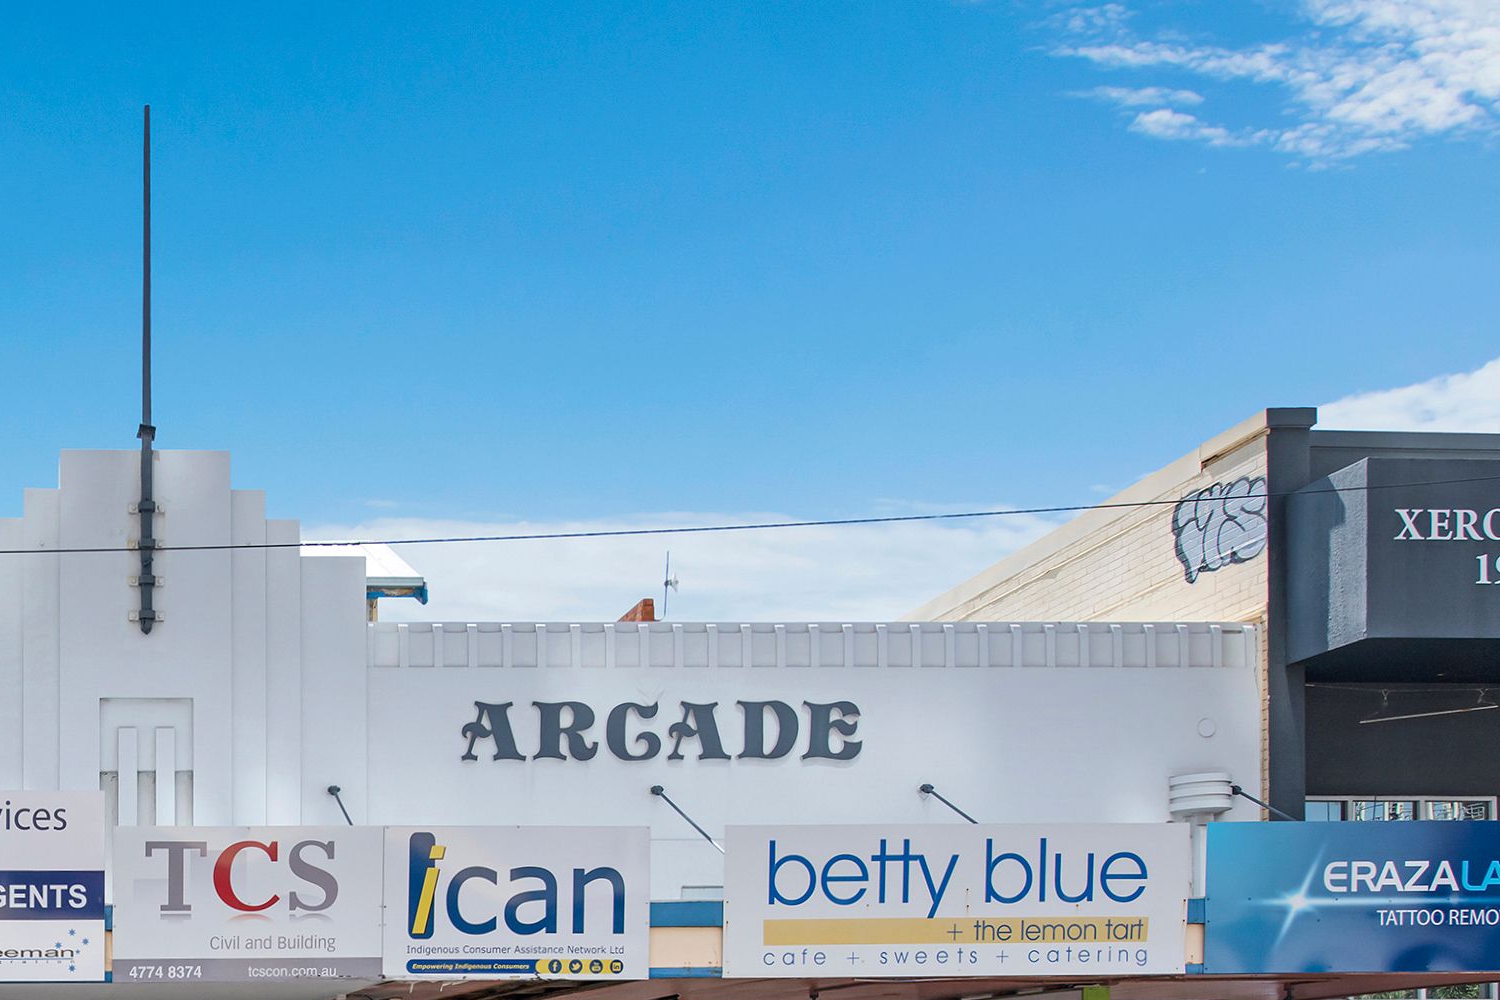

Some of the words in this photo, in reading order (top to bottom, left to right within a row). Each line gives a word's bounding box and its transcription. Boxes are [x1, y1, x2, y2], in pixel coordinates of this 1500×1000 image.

[1475, 553, 1500, 585] 1
[460, 699, 864, 762] ARCADE
[144, 839, 339, 913] TCS
[768, 838, 959, 918] betty
[985, 837, 1148, 904] blue
[1376, 909, 1445, 926] TATTOO
[1448, 909, 1500, 926] REMO
[974, 920, 1012, 941] the
[1021, 919, 1097, 941] lemon
[1105, 918, 1143, 941] tart
[209, 935, 240, 950] Civil
[245, 935, 272, 950] and
[278, 935, 336, 952] Building
[406, 944, 460, 955] Indigenous
[463, 944, 511, 954] Consumer
[514, 944, 564, 954] Assistance
[567, 944, 606, 954] Network
[610, 944, 625, 954] Ltd
[411, 963, 454, 971] Empowering
[454, 963, 492, 971] Indigenous
[493, 962, 530, 970] Consumers
[763, 949, 827, 967] cafe
[879, 948, 978, 966] sweets
[1028, 946, 1148, 967] catering
[129, 965, 163, 979] 4774
[168, 965, 202, 978] 8374
[248, 966, 337, 978] tcscon.com.au
